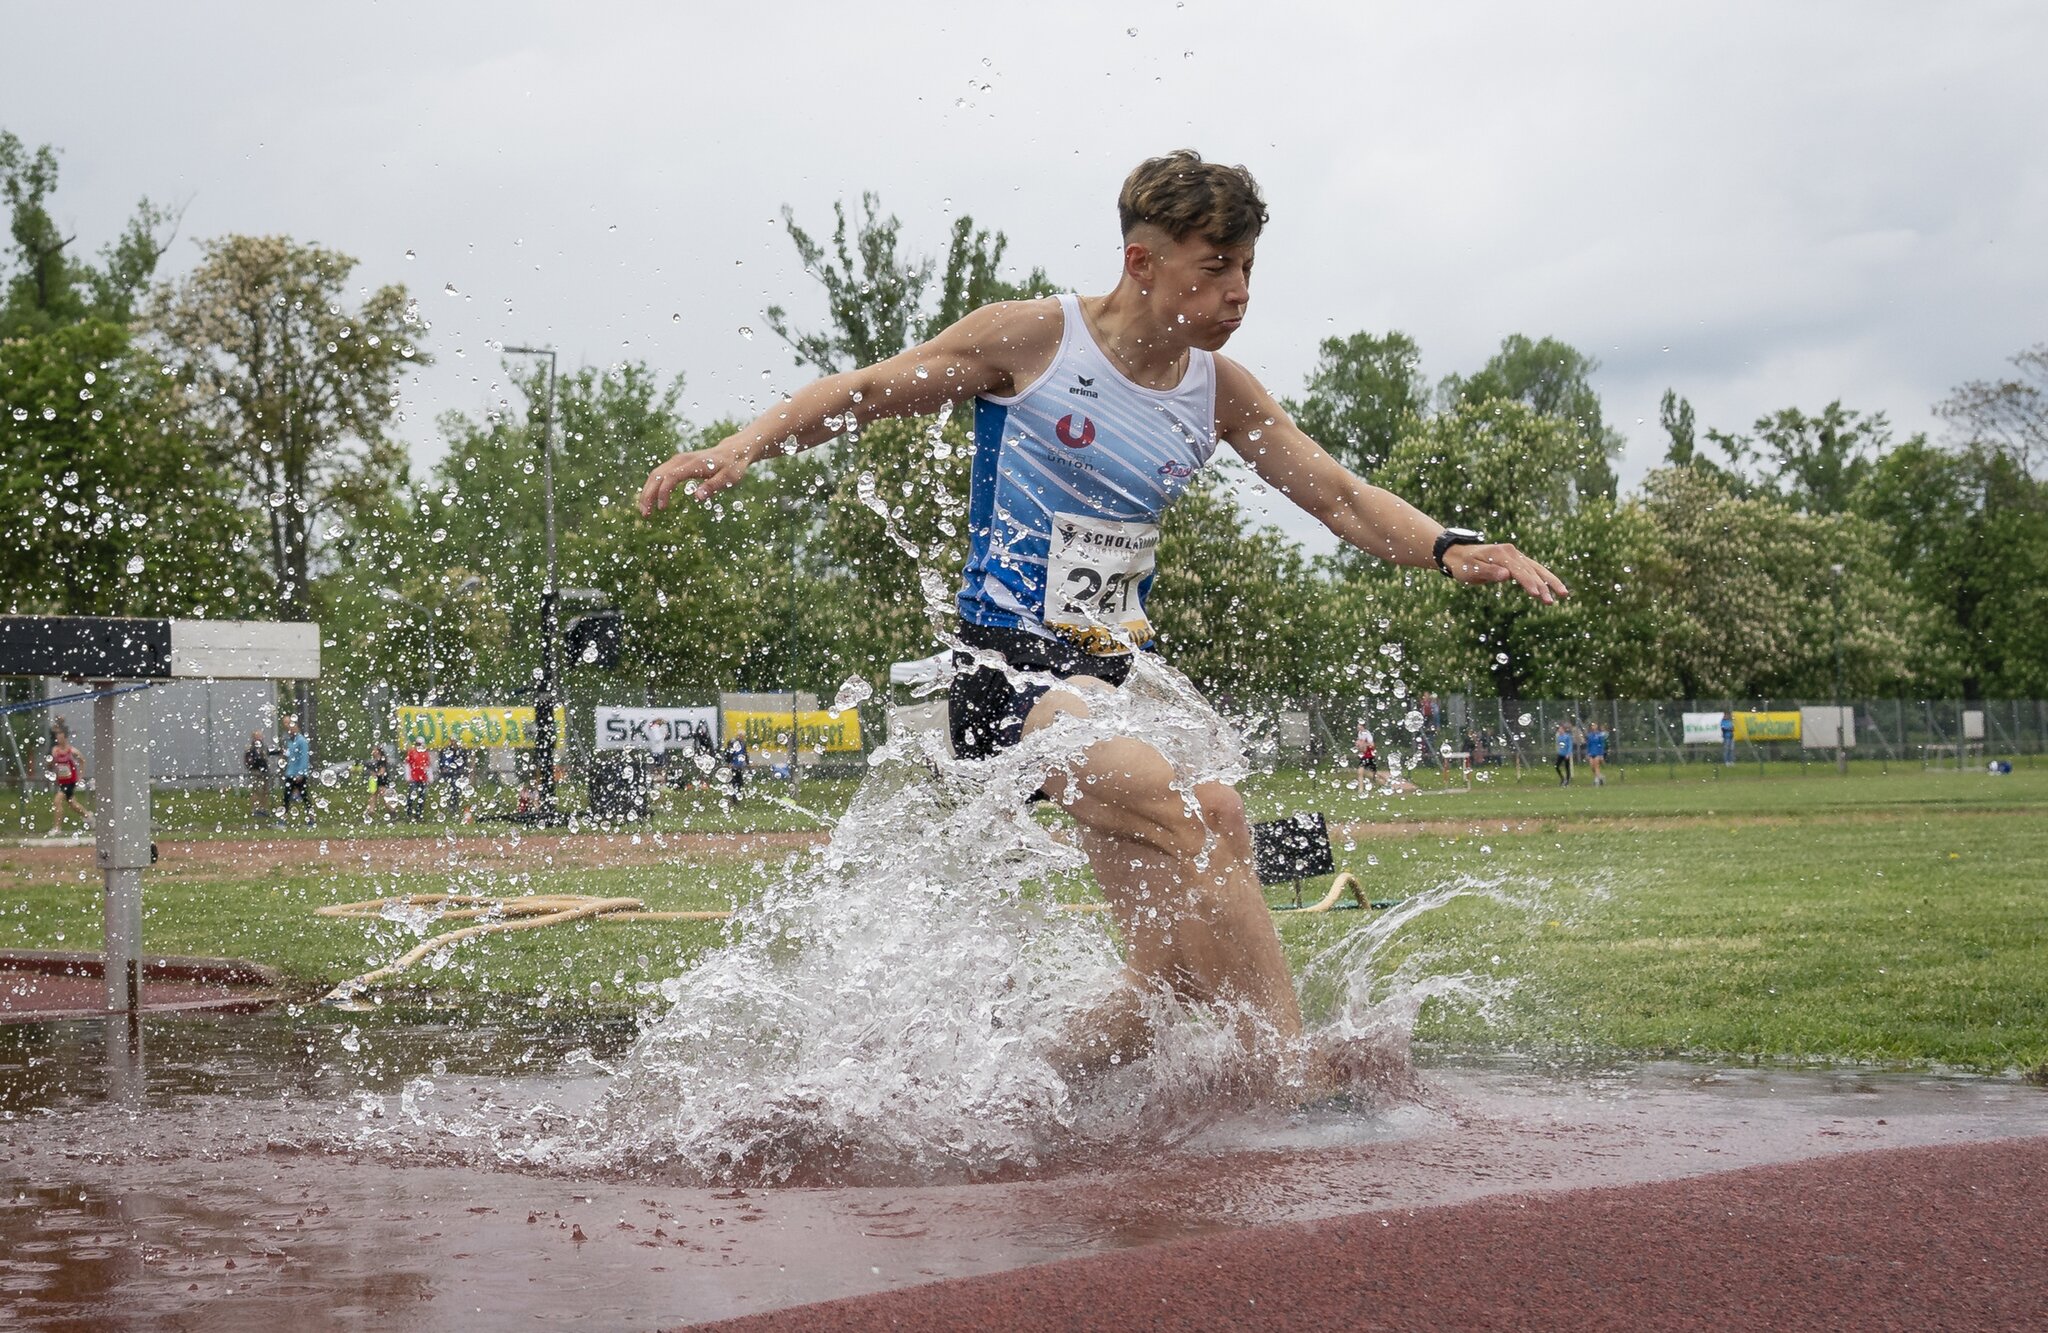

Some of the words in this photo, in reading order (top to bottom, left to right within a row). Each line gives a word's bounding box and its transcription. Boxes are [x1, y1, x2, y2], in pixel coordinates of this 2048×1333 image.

[1069, 387, 1098, 399] erima
[1047, 447, 1096, 463] SPORT
[1047, 454, 1094, 471] union
